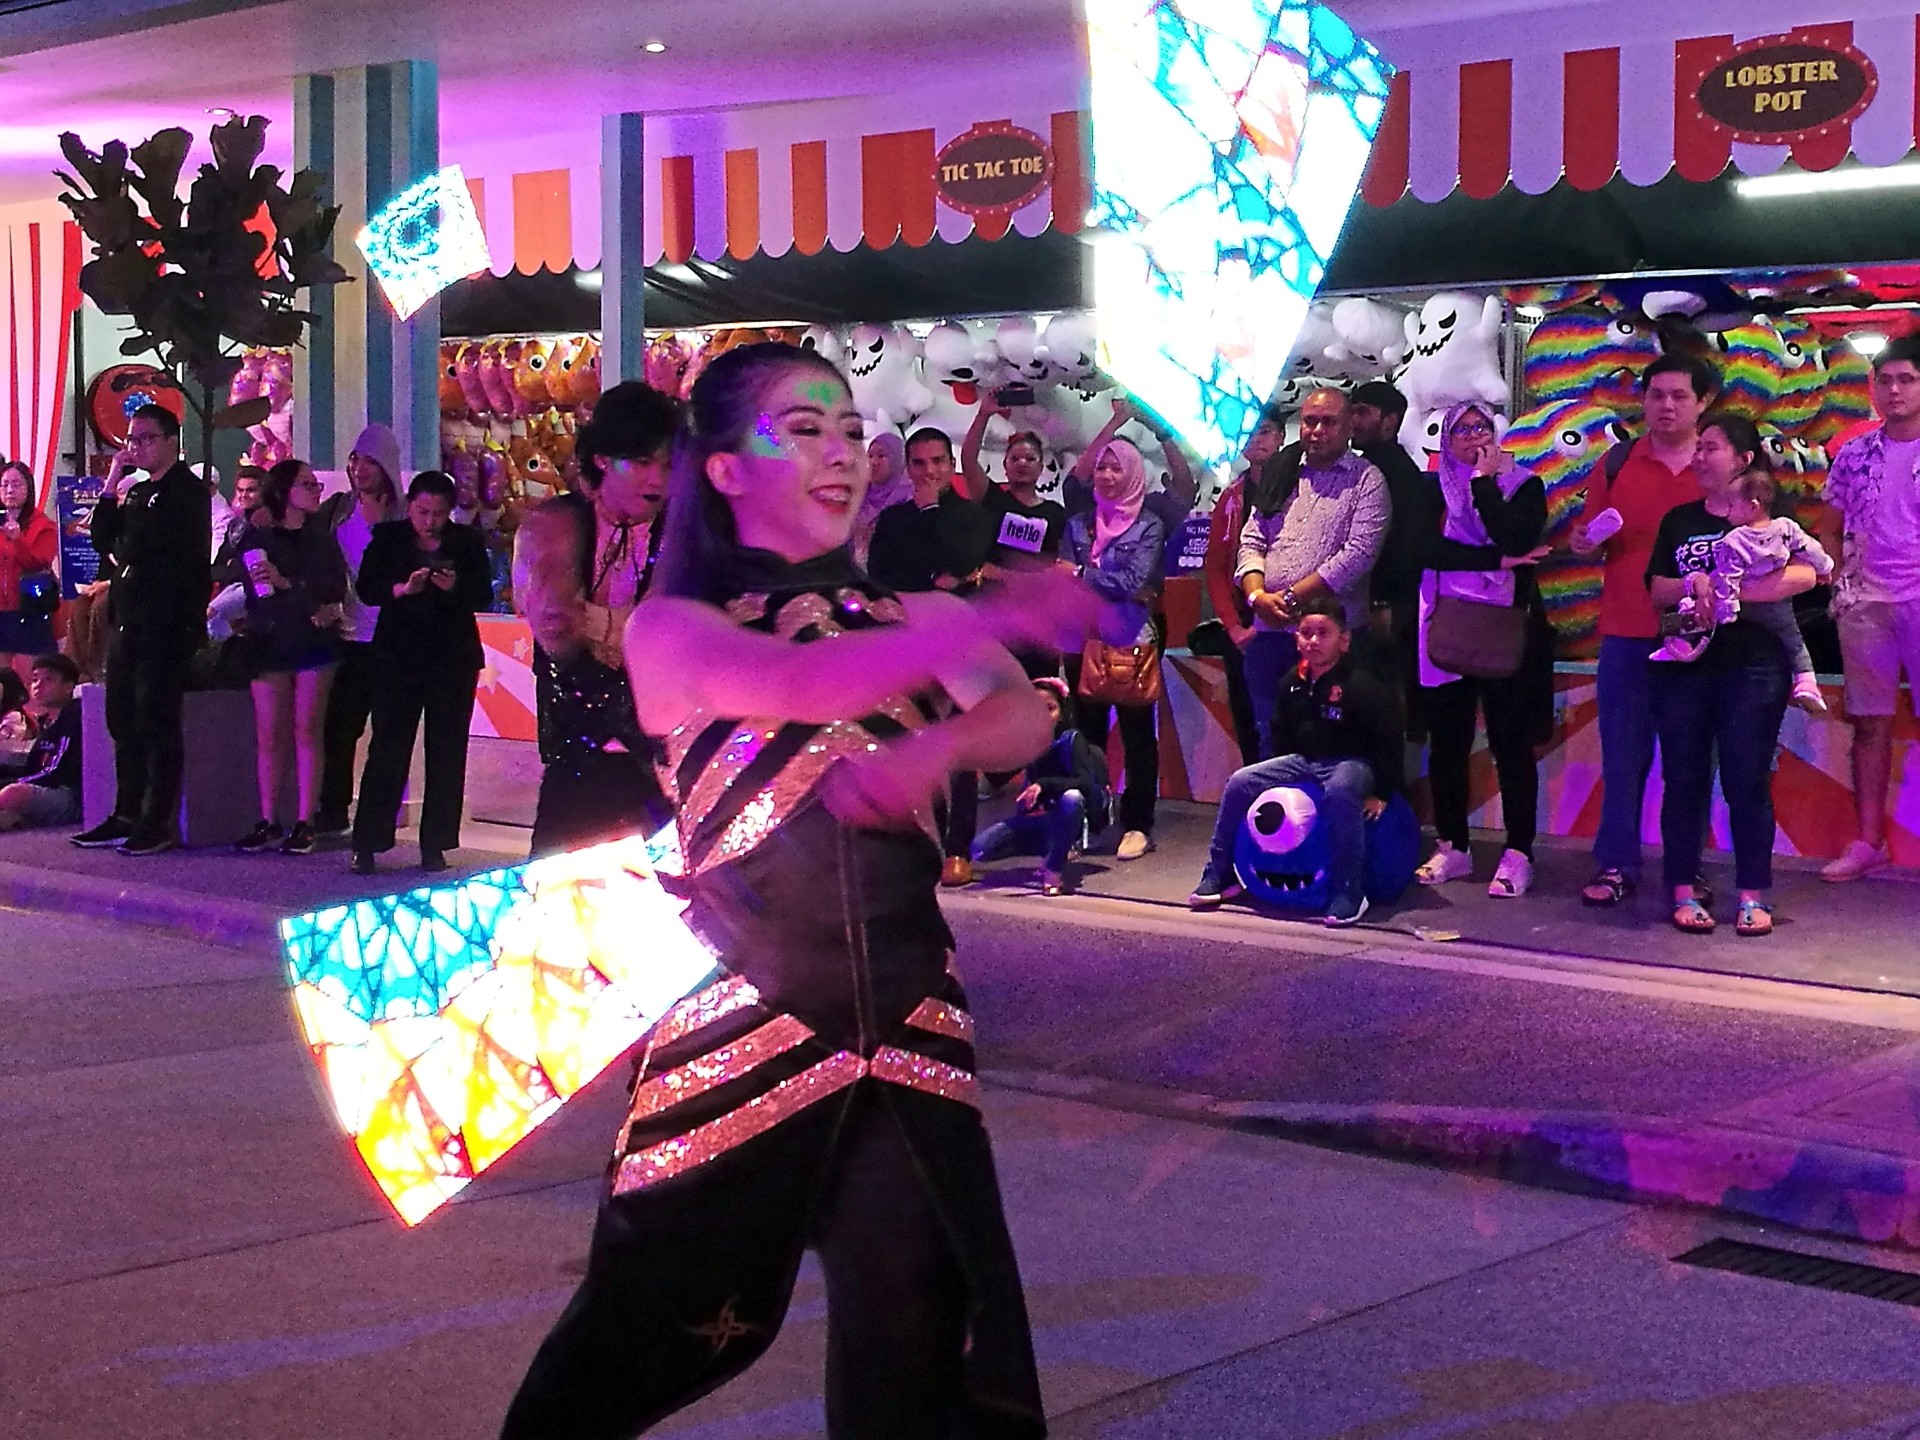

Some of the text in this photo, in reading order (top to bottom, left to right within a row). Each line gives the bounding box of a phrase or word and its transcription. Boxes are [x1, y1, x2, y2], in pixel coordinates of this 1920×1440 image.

[1725, 60, 1839, 88] LOBSTER
[1754, 89, 1807, 113] POT
[941, 156, 1043, 182] TIC TAC TOE
[1006, 519, 1041, 543] hello
